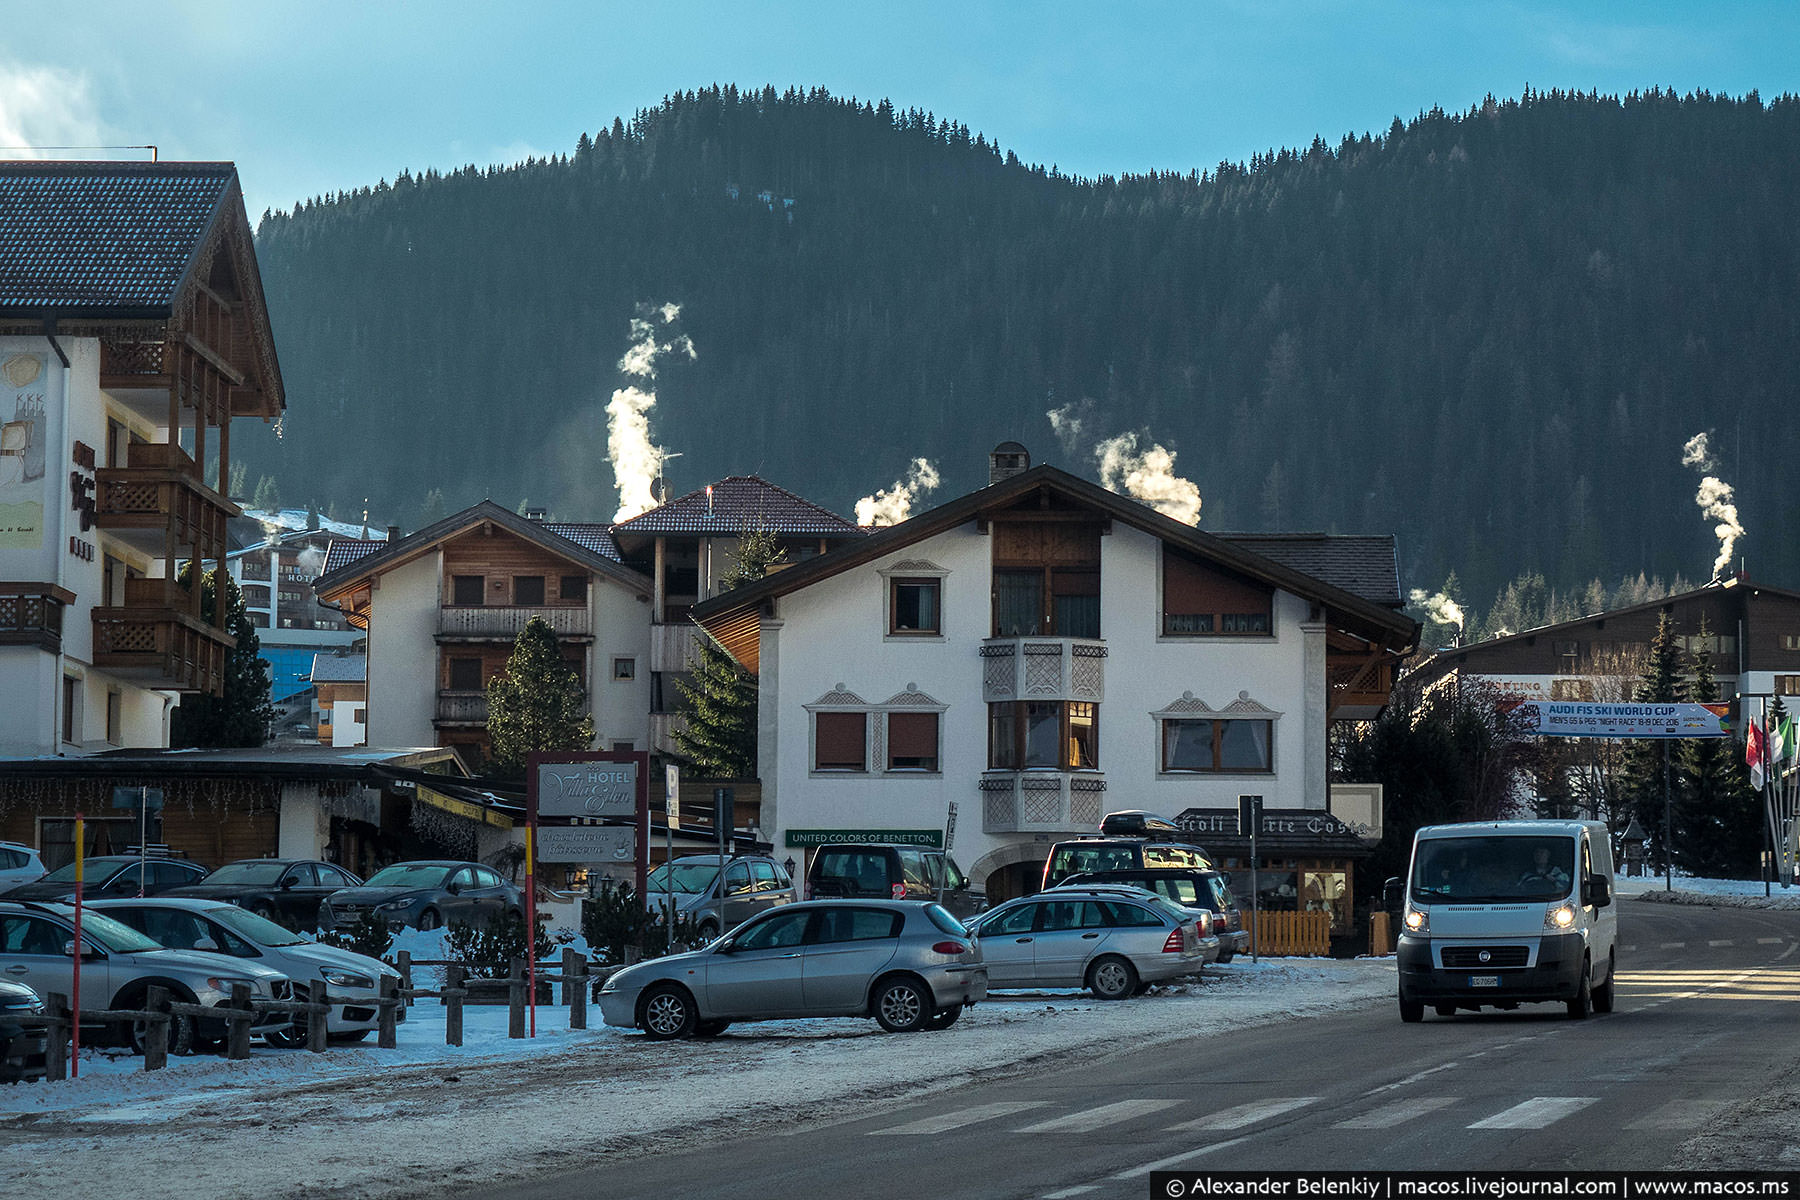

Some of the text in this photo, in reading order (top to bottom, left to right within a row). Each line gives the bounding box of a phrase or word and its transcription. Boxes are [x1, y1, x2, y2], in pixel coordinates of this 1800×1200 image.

[1549, 705, 1575, 715] AUDI
[1577, 705, 1593, 715] FIS
[1595, 706, 1612, 716] SKI
[1614, 706, 1653, 717] WORLD
[1655, 706, 1676, 717] CUP
[587, 772, 631, 784] HOTEL
[668, 769, 677, 797] P
[1306, 817, 1369, 835] Costa
[792, 834, 828, 843] UNITED
[829, 834, 868, 843] COLORS
[868, 834, 881, 843] OF
